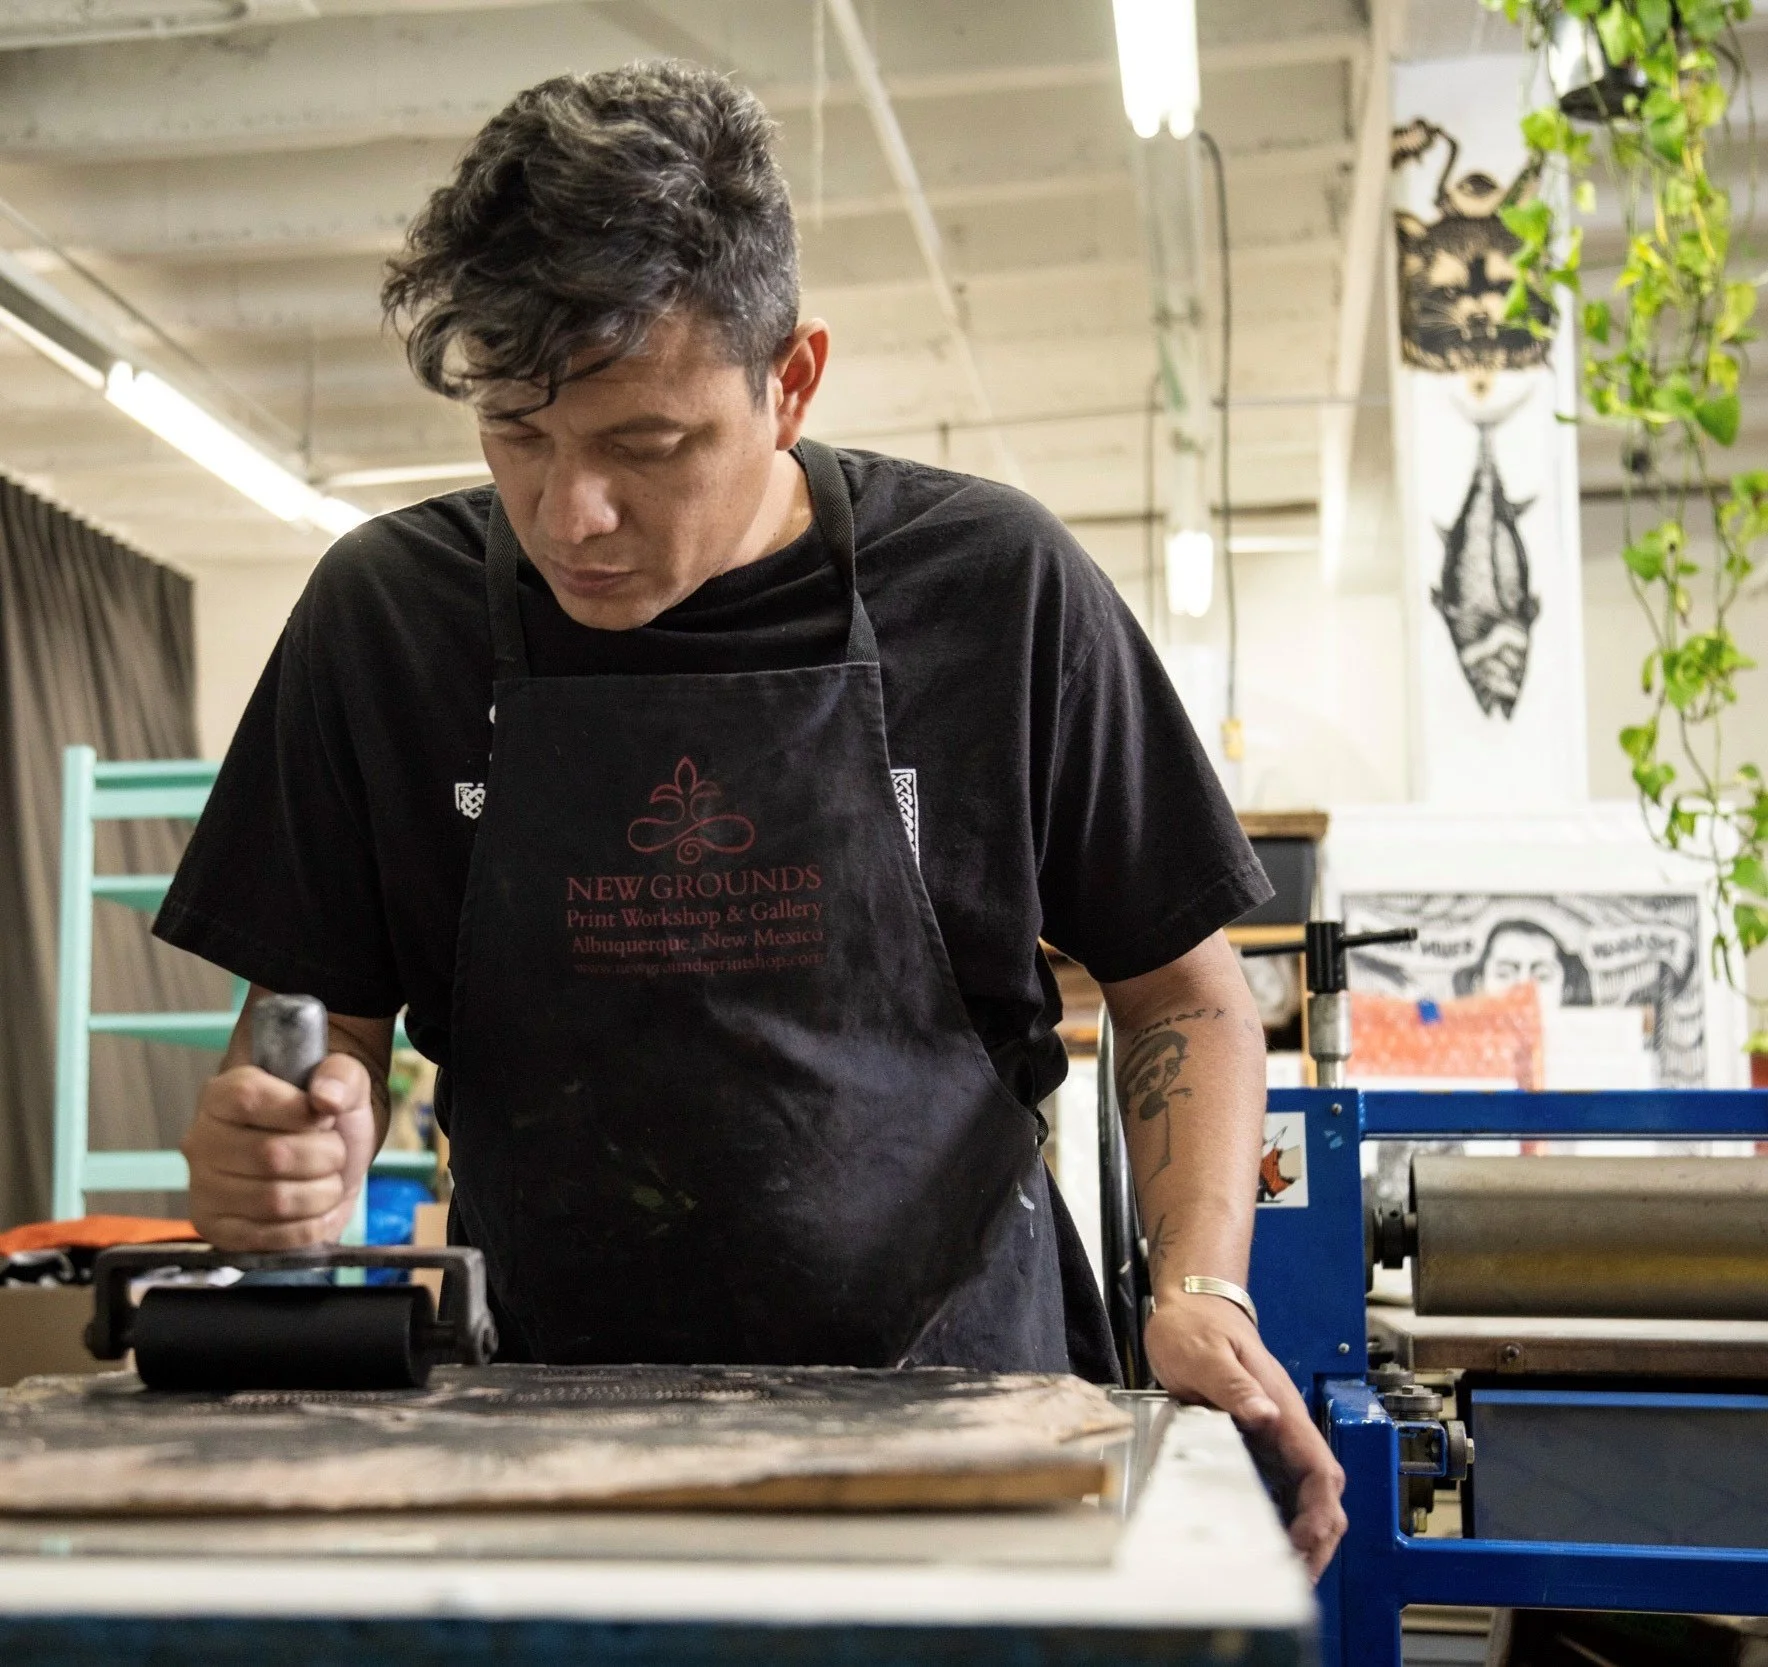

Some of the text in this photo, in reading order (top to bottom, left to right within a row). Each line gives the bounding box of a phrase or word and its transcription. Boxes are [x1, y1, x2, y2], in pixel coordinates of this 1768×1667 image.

[566, 864, 823, 901] NEW GROUNDS
[566, 899, 823, 930] Print Workshop & Gallery
[572, 926, 824, 958] Albuquerque, New Mexico
